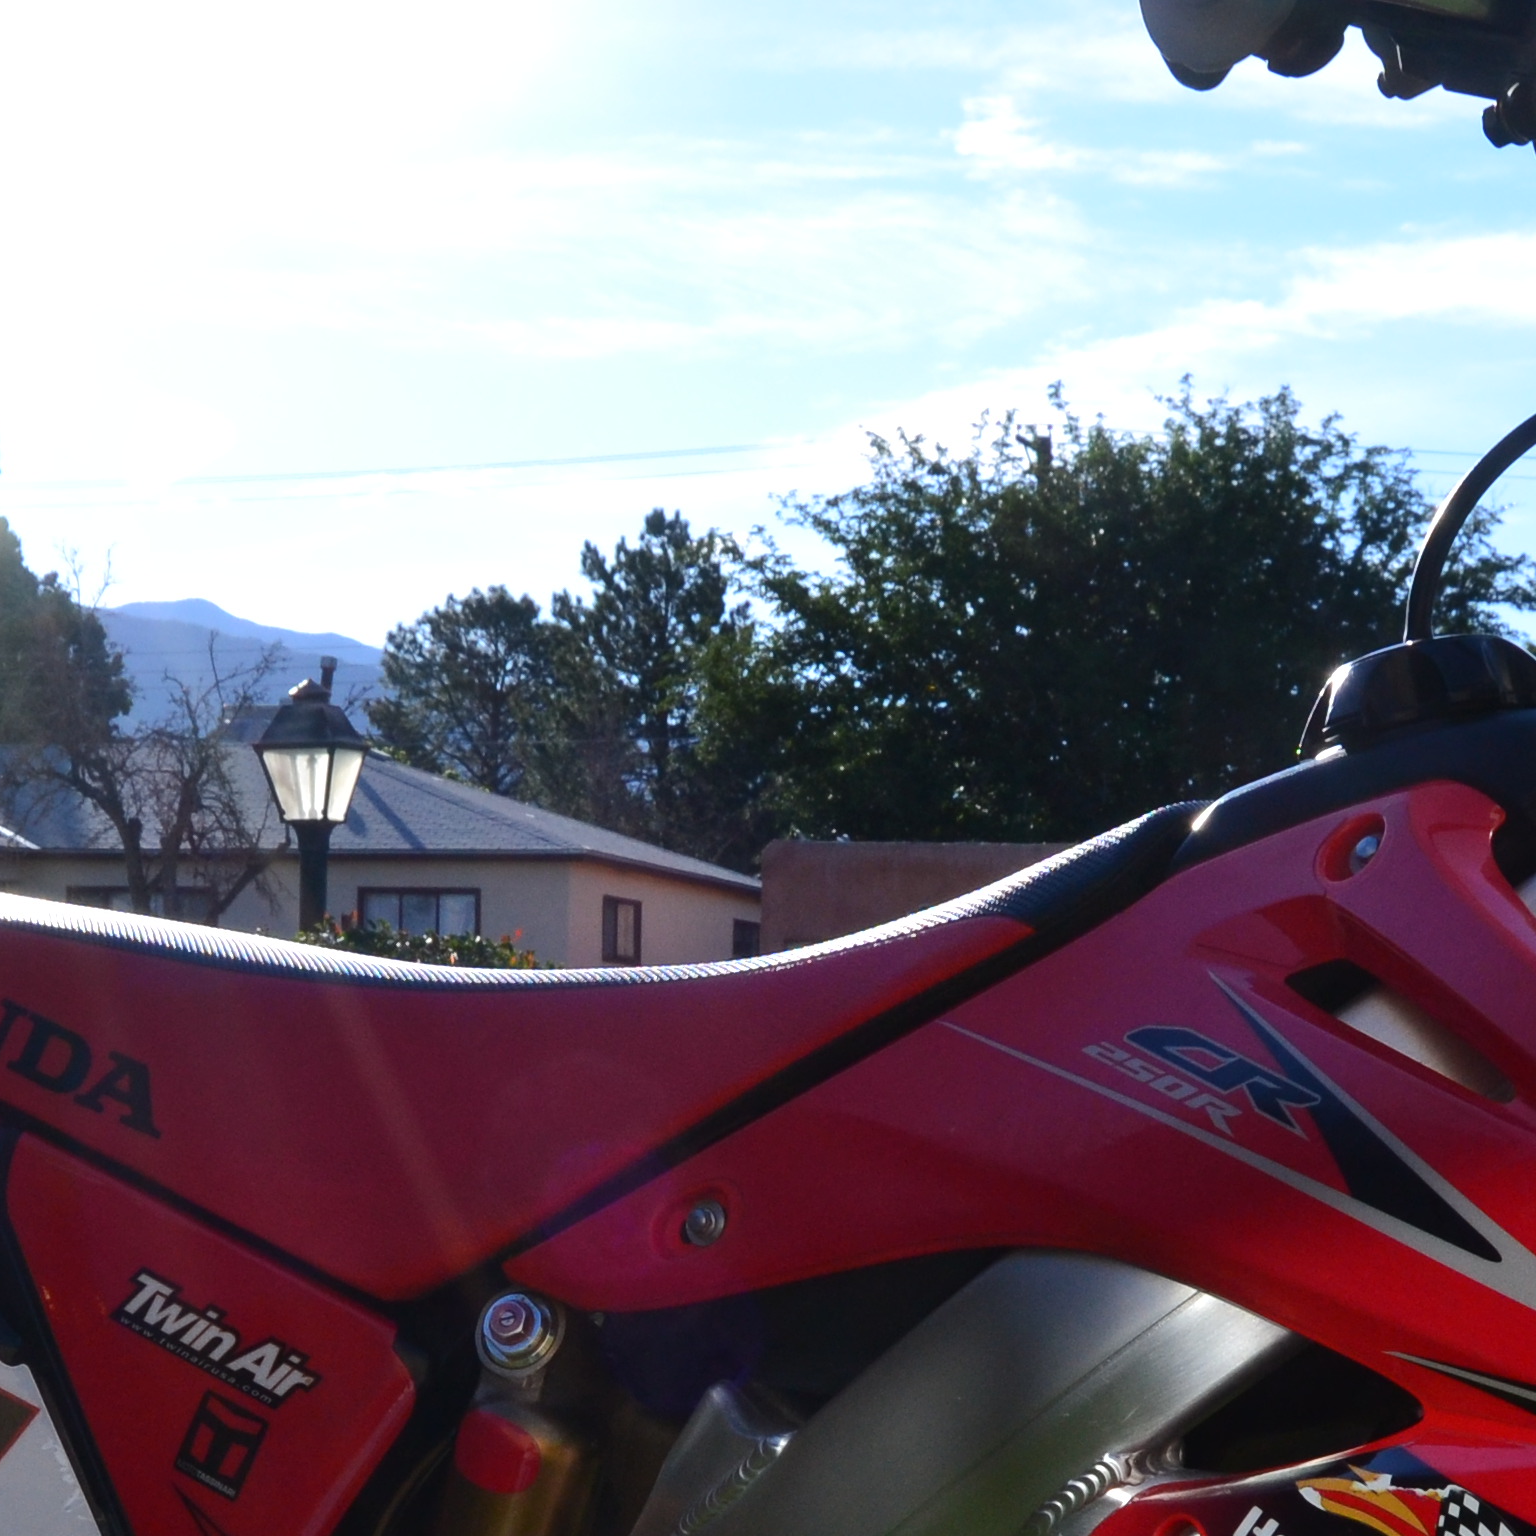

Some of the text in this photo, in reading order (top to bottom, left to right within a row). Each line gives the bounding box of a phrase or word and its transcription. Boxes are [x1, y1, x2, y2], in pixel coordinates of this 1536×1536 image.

[1081, 1040, 1243, 1137] 250R
[119, 1314, 273, 1406] www.twinairusa.com
[124, 1272, 315, 1398] Twin Air
